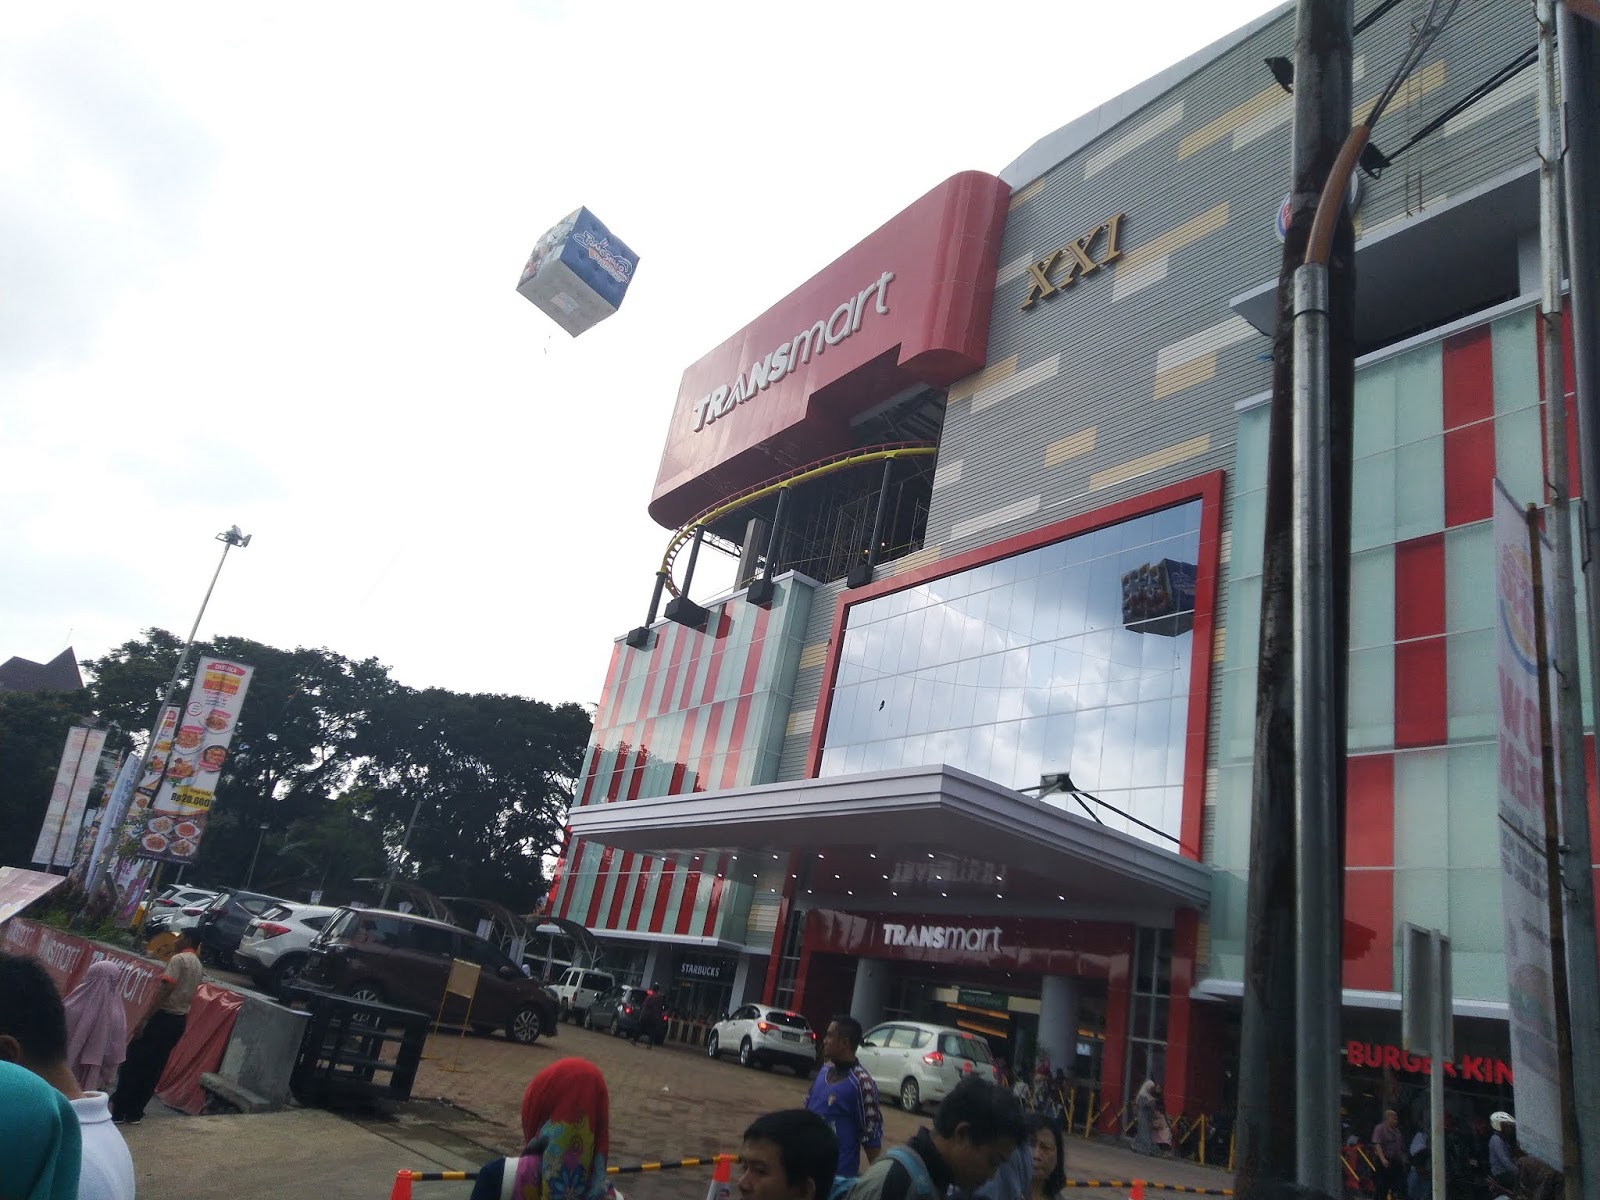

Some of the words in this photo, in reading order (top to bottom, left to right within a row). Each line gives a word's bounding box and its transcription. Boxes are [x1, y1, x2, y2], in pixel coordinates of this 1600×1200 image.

[1021, 212, 1125, 310] XXI
[693, 271, 896, 432] TRANSmart
[681, 963, 720, 977] STARBUCKS
[883, 924, 1002, 953] TRANSmart
